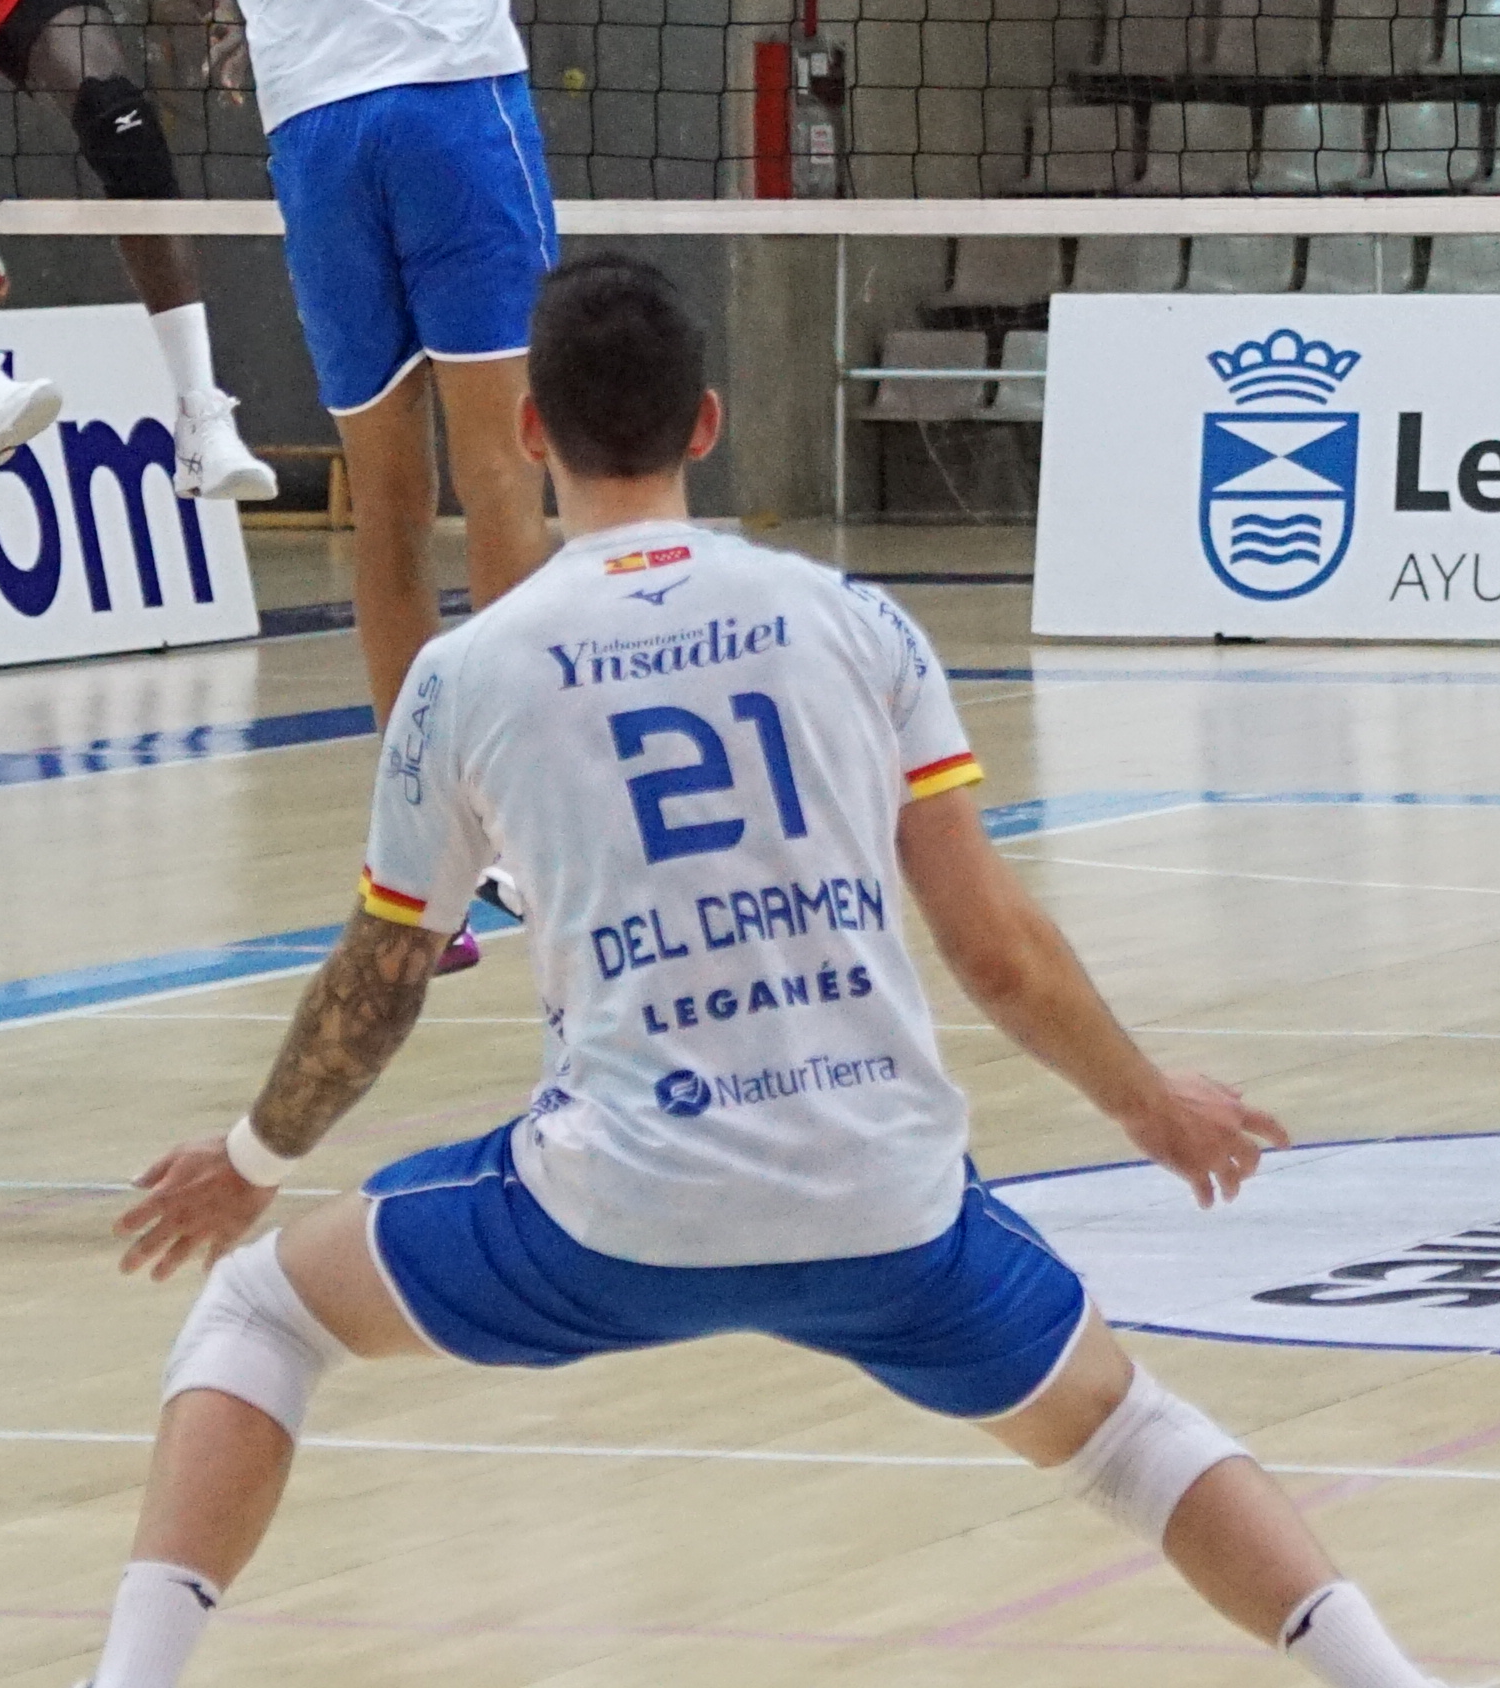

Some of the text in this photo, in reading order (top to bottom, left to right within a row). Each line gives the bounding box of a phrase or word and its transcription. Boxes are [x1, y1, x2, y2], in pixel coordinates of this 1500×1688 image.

[547, 615, 792, 691] Ynsadiet
[608, 690, 808, 865] 21
[591, 876, 886, 981] DEL CARMEN
[643, 962, 874, 1036] LEGANÉS
[714, 1053, 896, 1109] NaturTierra
